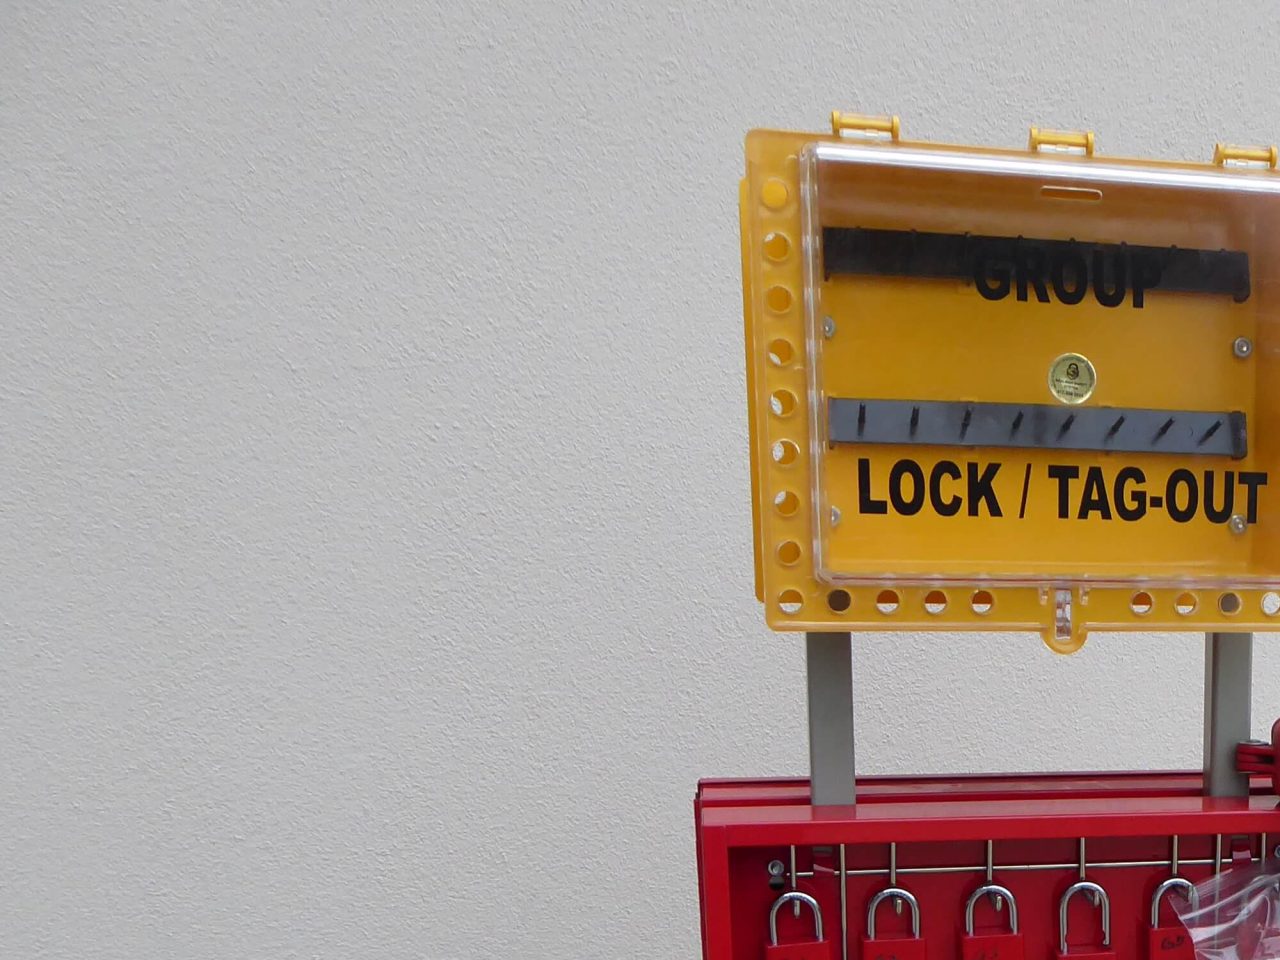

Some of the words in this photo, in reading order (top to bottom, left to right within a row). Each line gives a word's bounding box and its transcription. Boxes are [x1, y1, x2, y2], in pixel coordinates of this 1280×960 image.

[974, 247, 1161, 308] GROUP
[858, 458, 1003, 517] LOCK
[1018, 463, 1032, 519] /
[1048, 465, 1268, 524] TAG-OUT
